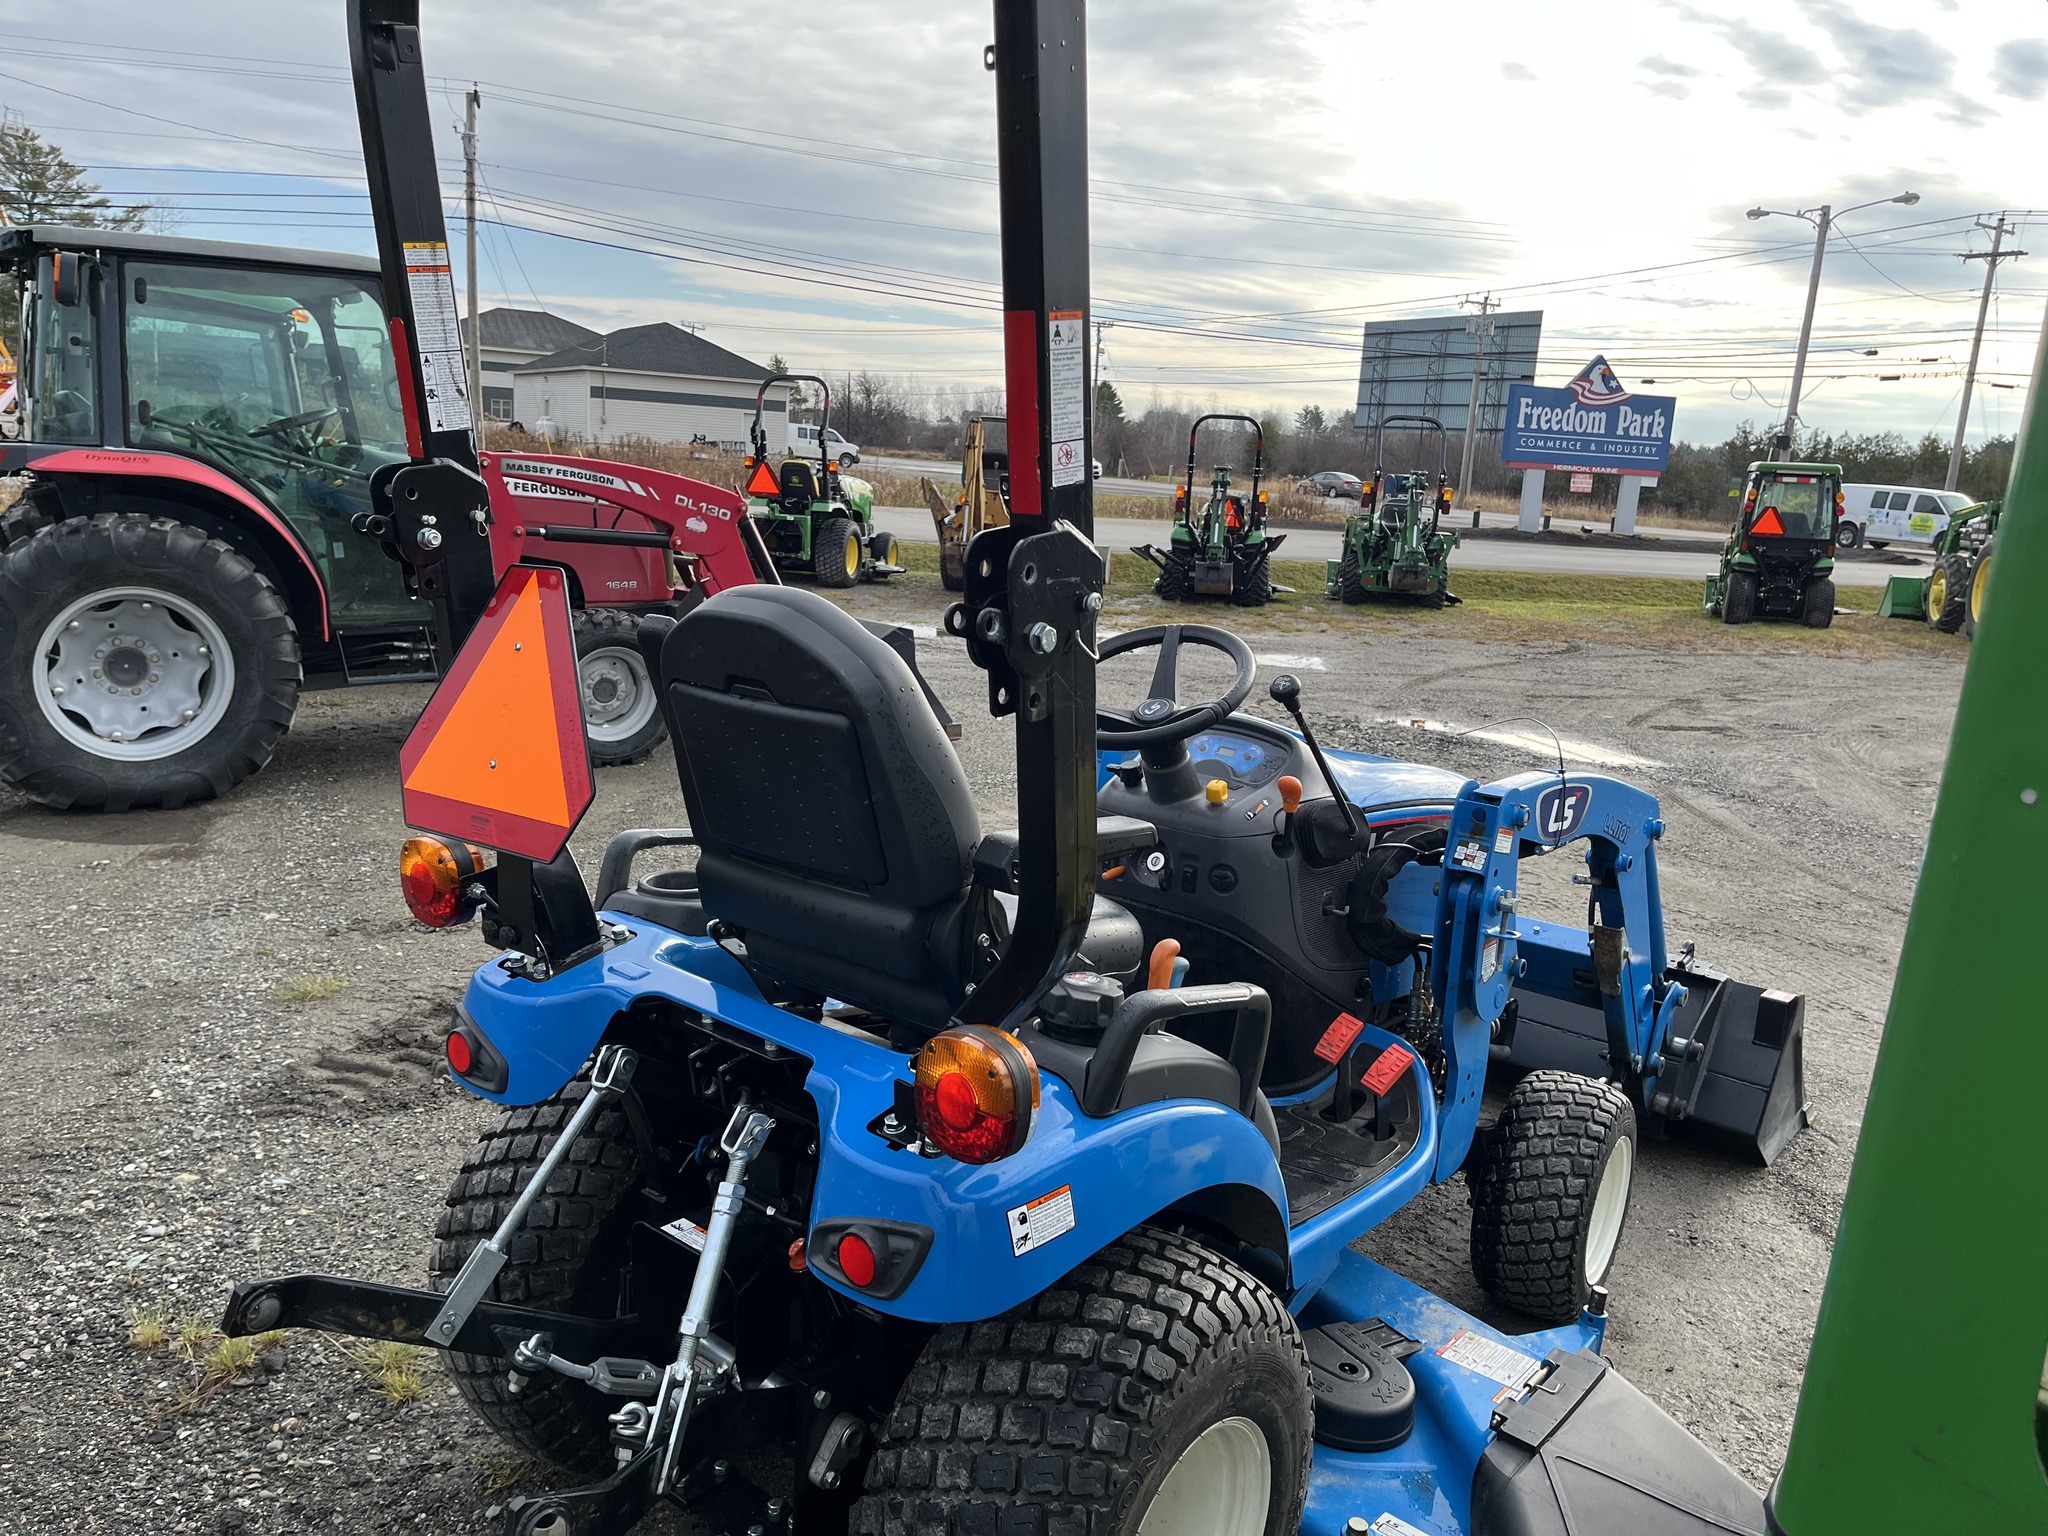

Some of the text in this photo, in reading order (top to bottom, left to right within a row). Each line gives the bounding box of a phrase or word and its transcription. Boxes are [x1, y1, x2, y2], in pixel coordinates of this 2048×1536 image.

[1516, 397, 1666, 438] Freedom Park
[1520, 437, 1658, 455] COMMERCE & INDUSTRY
[505, 462, 615, 486] MASSEY FERGUSON
[1592, 466, 1619, 474] MAINE
[605, 580, 638, 590] 1648
[1144, 701, 1161, 715] LS
[1547, 795, 1578, 833] LS
